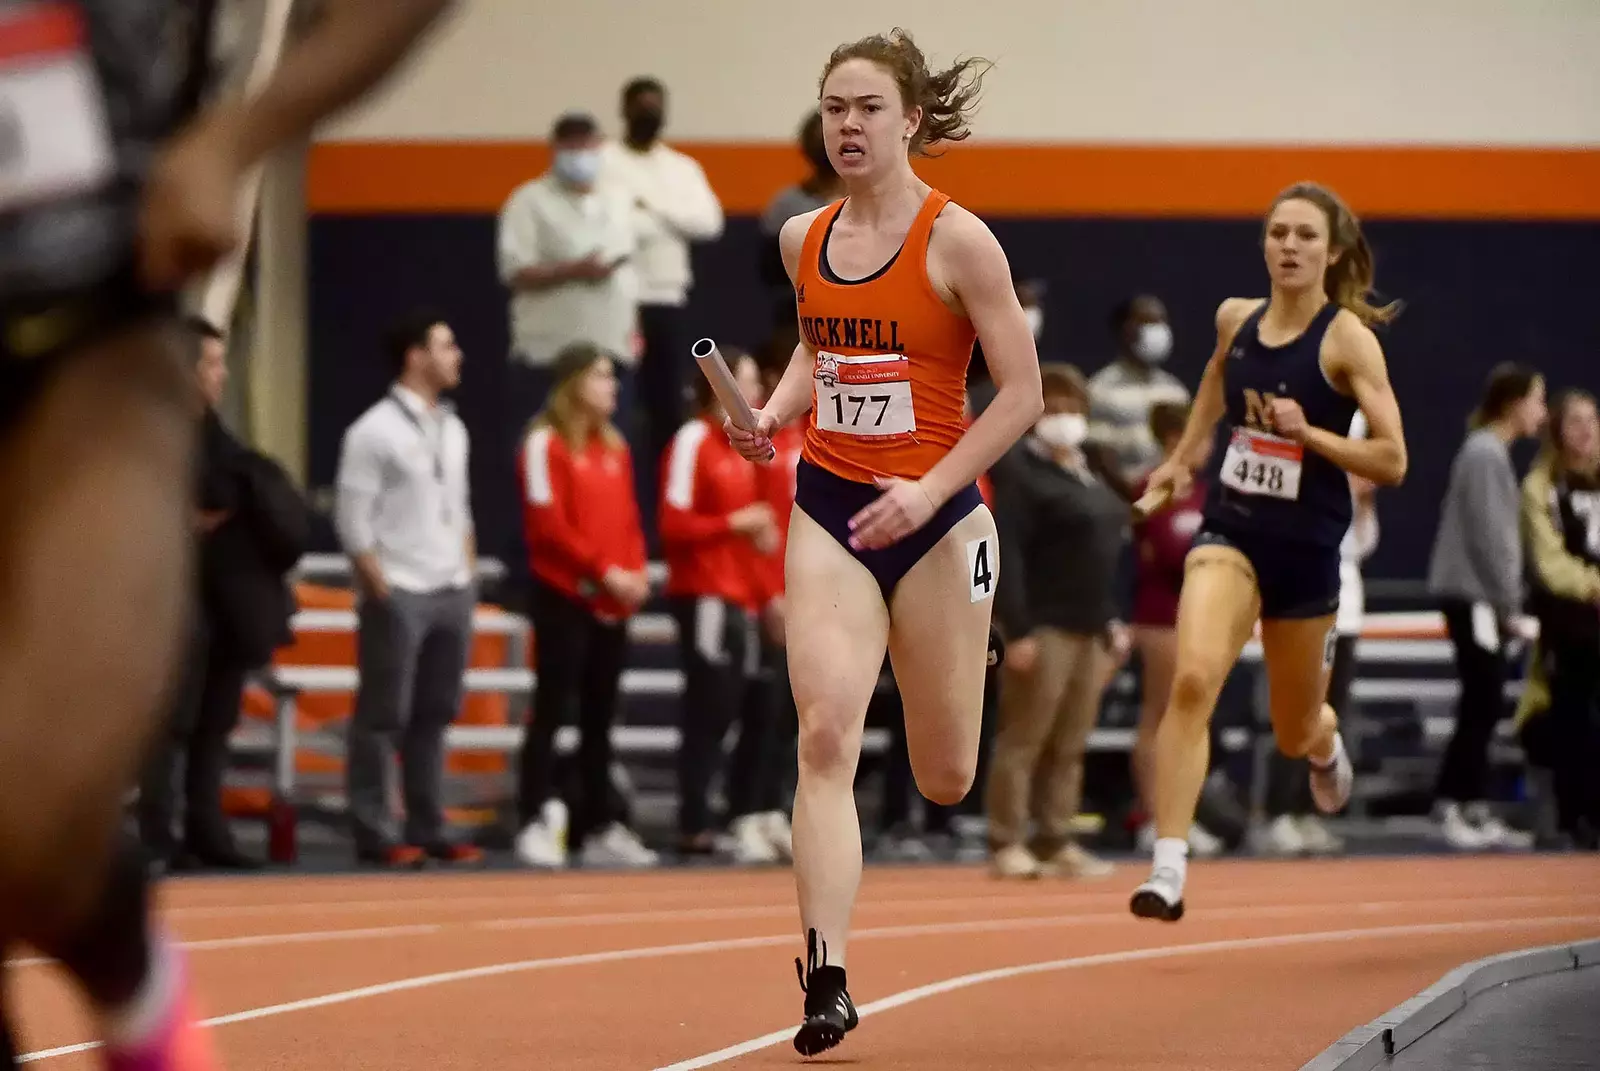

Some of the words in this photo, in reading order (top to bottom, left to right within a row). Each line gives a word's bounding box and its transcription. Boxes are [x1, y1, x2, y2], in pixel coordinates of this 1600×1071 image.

[799, 316, 905, 351] UCKNELL
[870, 371, 899, 379] UNIVERSITY
[830, 392, 892, 427] 177
[1233, 459, 1283, 493] 448
[973, 540, 992, 594] 4
